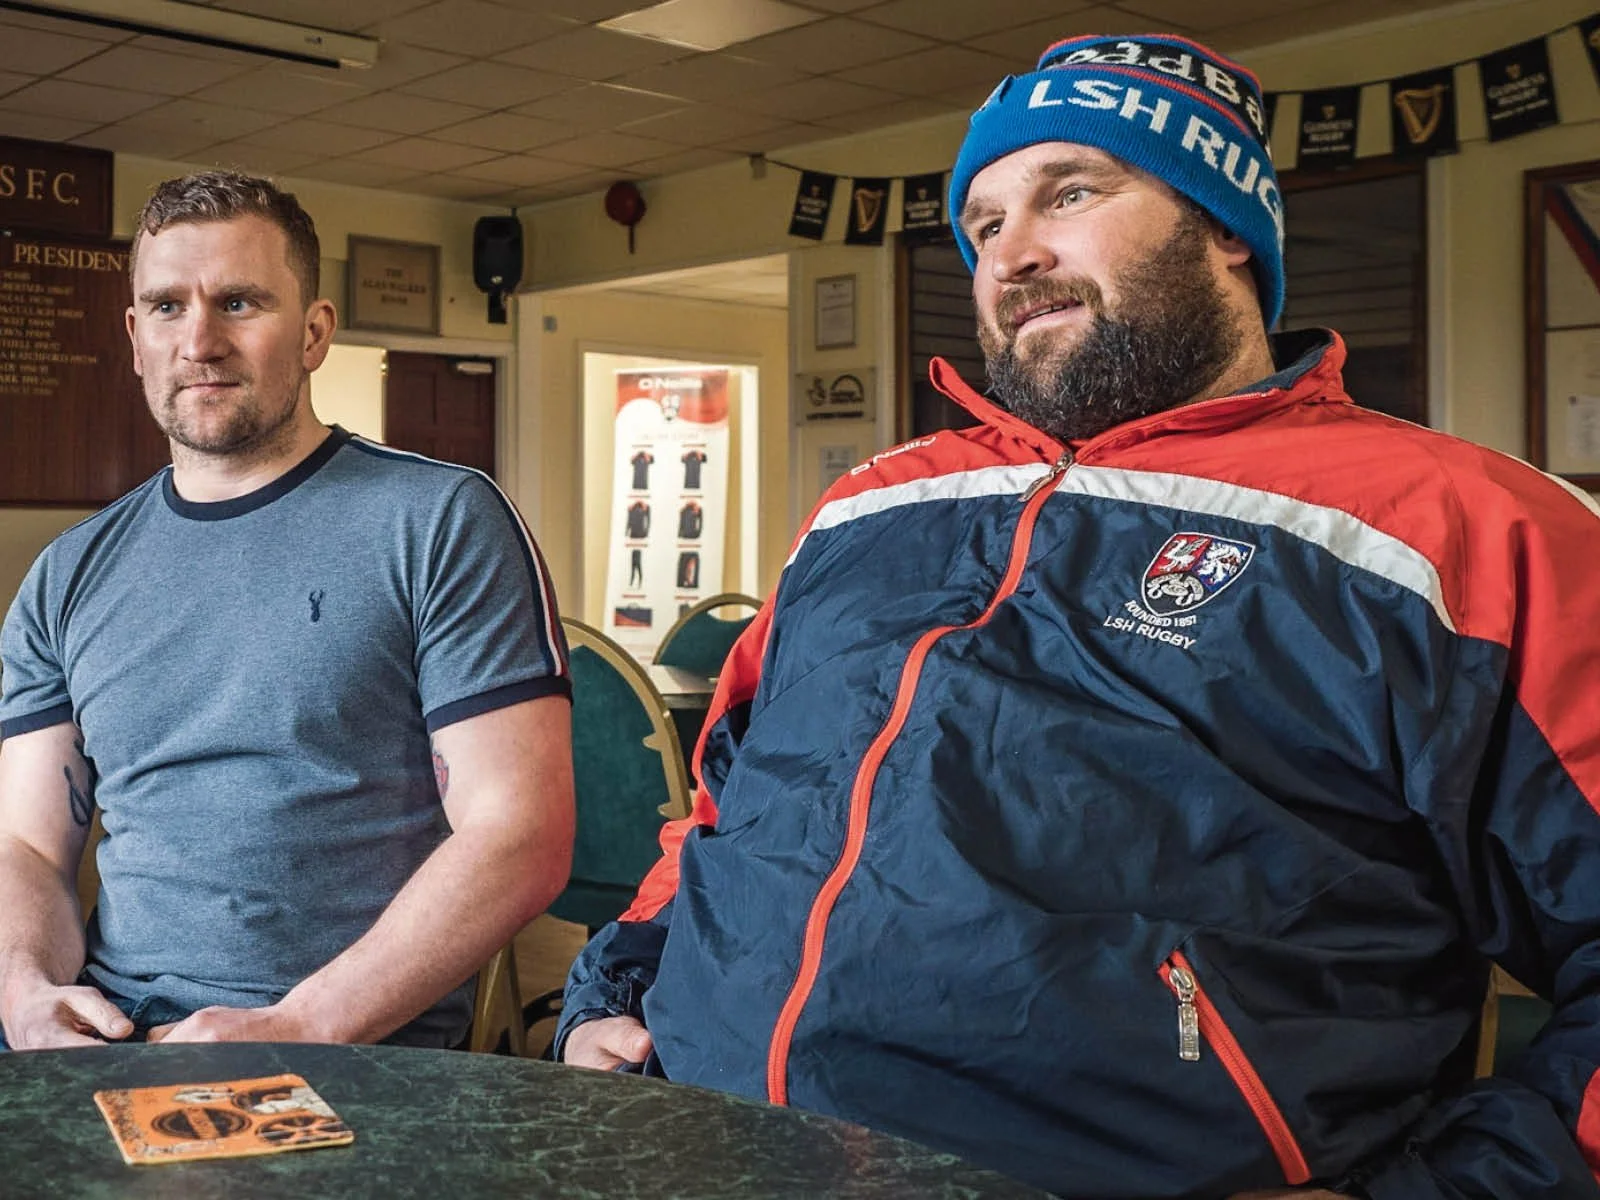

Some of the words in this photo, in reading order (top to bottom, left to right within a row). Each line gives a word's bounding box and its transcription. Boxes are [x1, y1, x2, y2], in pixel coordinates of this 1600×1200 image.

[1047, 41, 1271, 158] oadBa
[1028, 79, 1172, 134] LSH
[1181, 114, 1284, 256] RUG
[1103, 615, 1136, 632] LSH
[1136, 623, 1197, 650] RUGBY
[1124, 600, 1172, 627] FOUNDED
